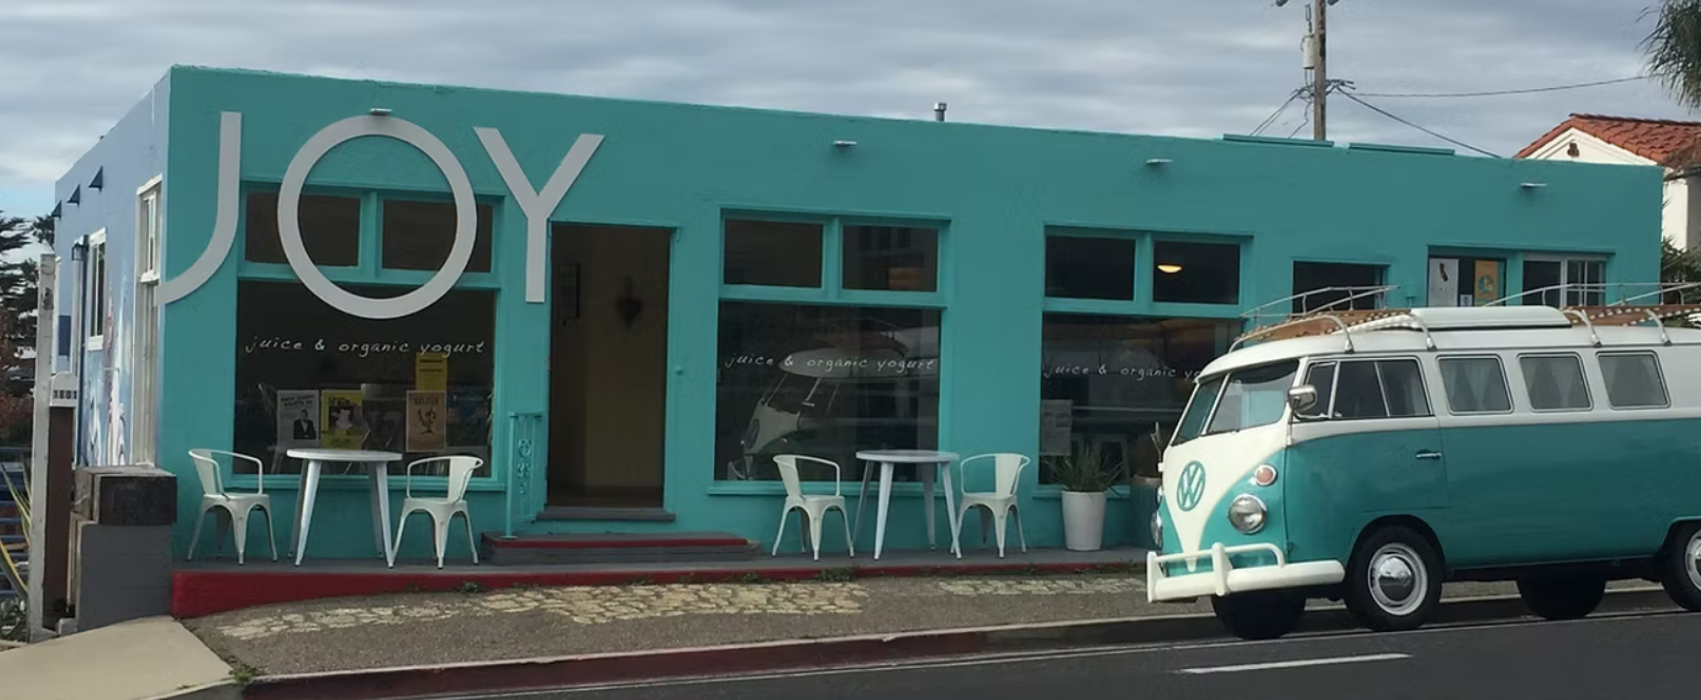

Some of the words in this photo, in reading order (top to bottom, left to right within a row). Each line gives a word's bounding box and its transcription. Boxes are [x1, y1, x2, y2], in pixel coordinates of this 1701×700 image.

[155, 111, 605, 319] JOY
[245, 336, 303, 354] juice
[314, 338, 326, 351] &
[338, 340, 410, 358] organic
[419, 341, 485, 359] yogurt
[724, 353, 775, 369] juice
[784, 354, 794, 367] &
[806, 356, 868, 373] organic
[876, 359, 934, 374] yogurt
[1043, 362, 1090, 379] juice
[1098, 363, 1108, 375] &
[1120, 366, 1176, 381] organic
